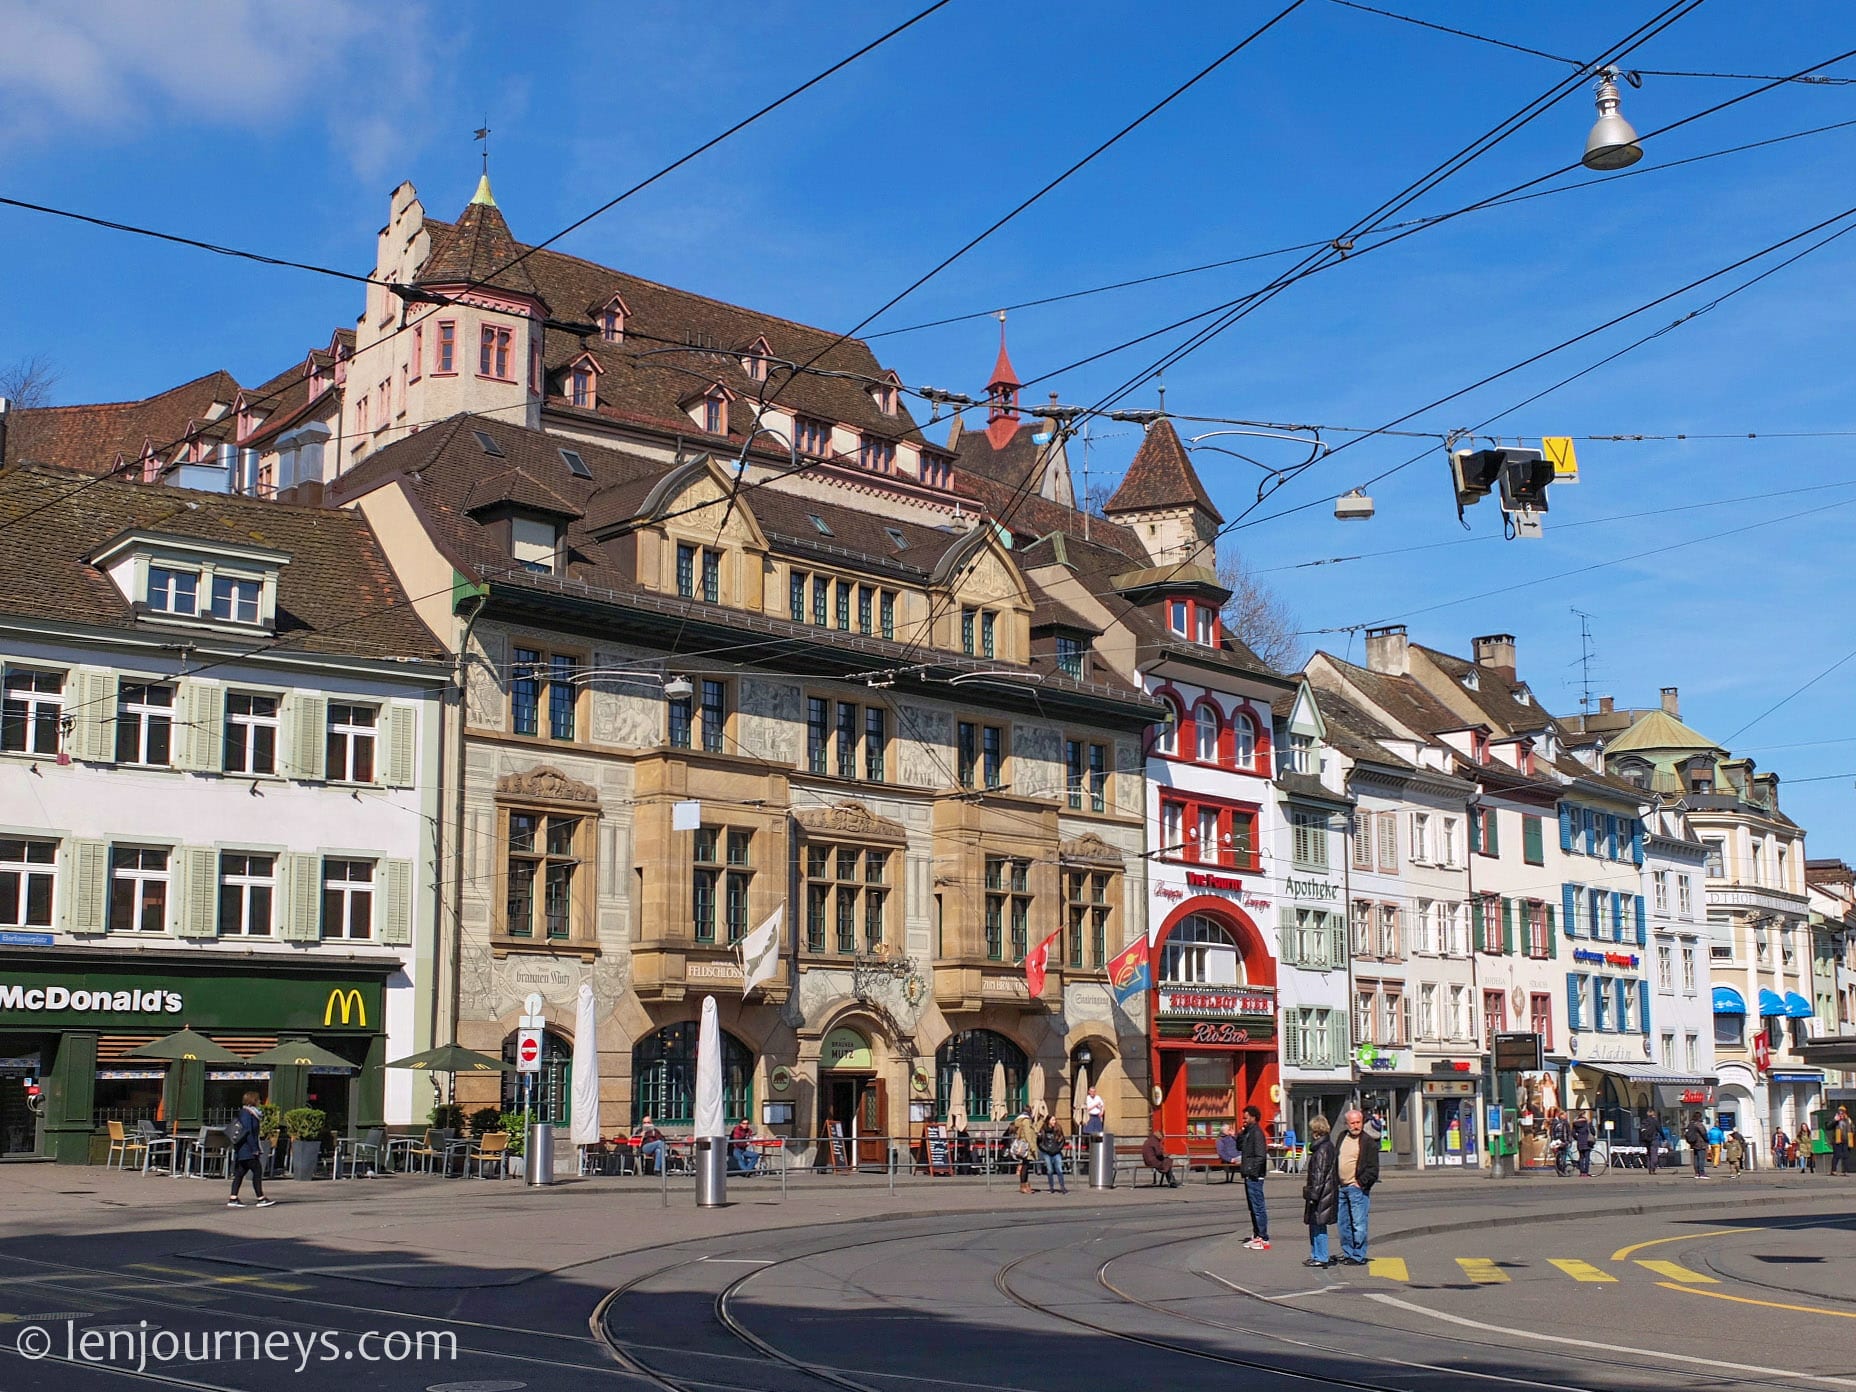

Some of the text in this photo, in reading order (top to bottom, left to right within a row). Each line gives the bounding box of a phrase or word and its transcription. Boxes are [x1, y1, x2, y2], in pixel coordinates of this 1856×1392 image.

[1285, 875, 1339, 900] Apotheke
[0, 984, 183, 1013] McDonald's
[1192, 1022, 1219, 1043] Rio
[831, 1049, 854, 1059] MUTZ
